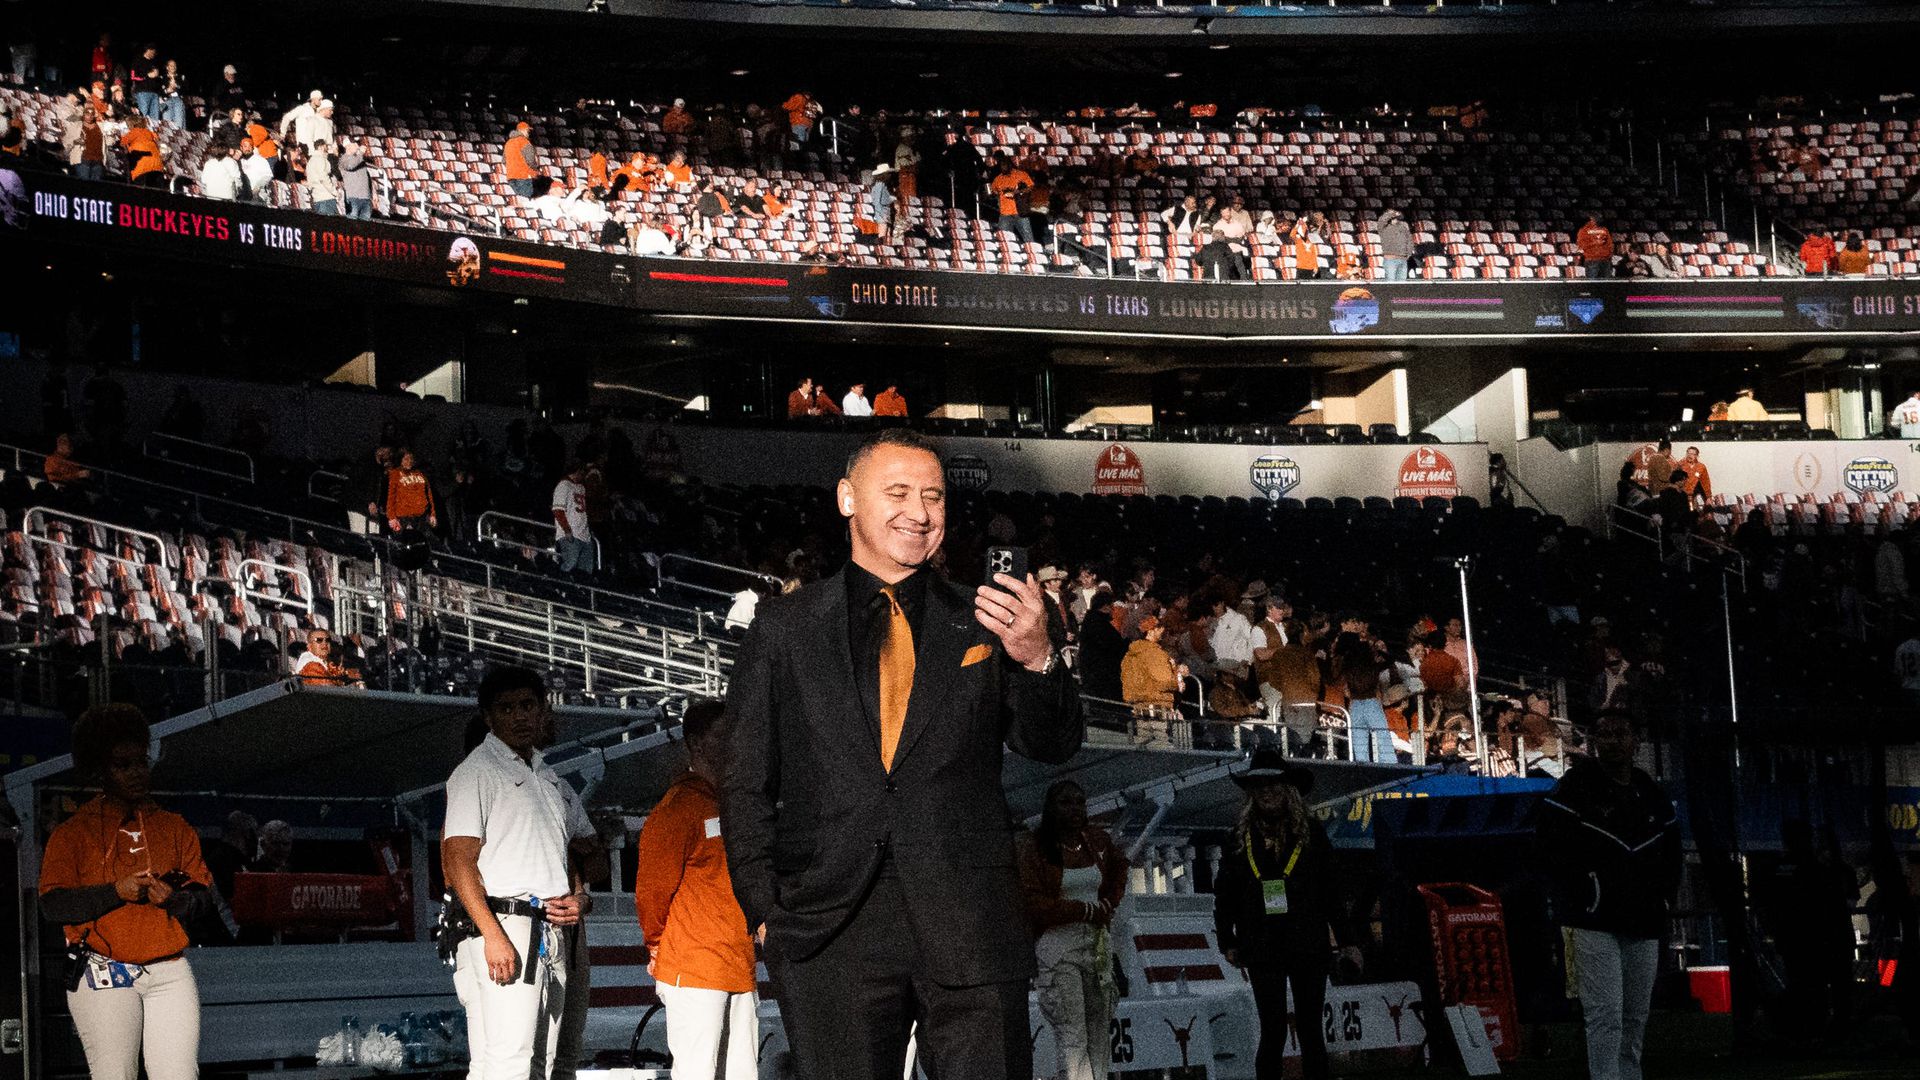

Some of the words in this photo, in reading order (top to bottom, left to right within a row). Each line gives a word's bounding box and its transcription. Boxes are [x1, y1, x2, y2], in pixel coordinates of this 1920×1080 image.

[35, 191, 68, 218] OHIO
[73, 197, 113, 225] STATE
[119, 203, 229, 241] BUCKEYES
[239, 222, 254, 245] VS
[263, 223, 302, 251] TEXAS
[852, 283, 887, 305] OHIO
[894, 284, 938, 307] STATE
[1079, 296, 1096, 315] VS
[1107, 294, 1149, 317] TEXAS
[1159, 300, 1318, 320] LONGHORNS
[1853, 295, 1895, 316] OHIO
[1903, 410, 1919, 425] 16
[1004, 442, 1021, 453] 144
[1098, 468, 1119, 480] LIVE
[1253, 468, 1297, 485] COTTON
[1402, 470, 1427, 482] LIVE
[1847, 470, 1895, 486] COTTON
[1260, 477, 1289, 488] BOWL
[1856, 480, 1888, 490] BOWL
[291, 885, 361, 910] GATORADE
[1448, 912, 1500, 923] GATORADE
[1109, 1017, 1134, 1064] 25
